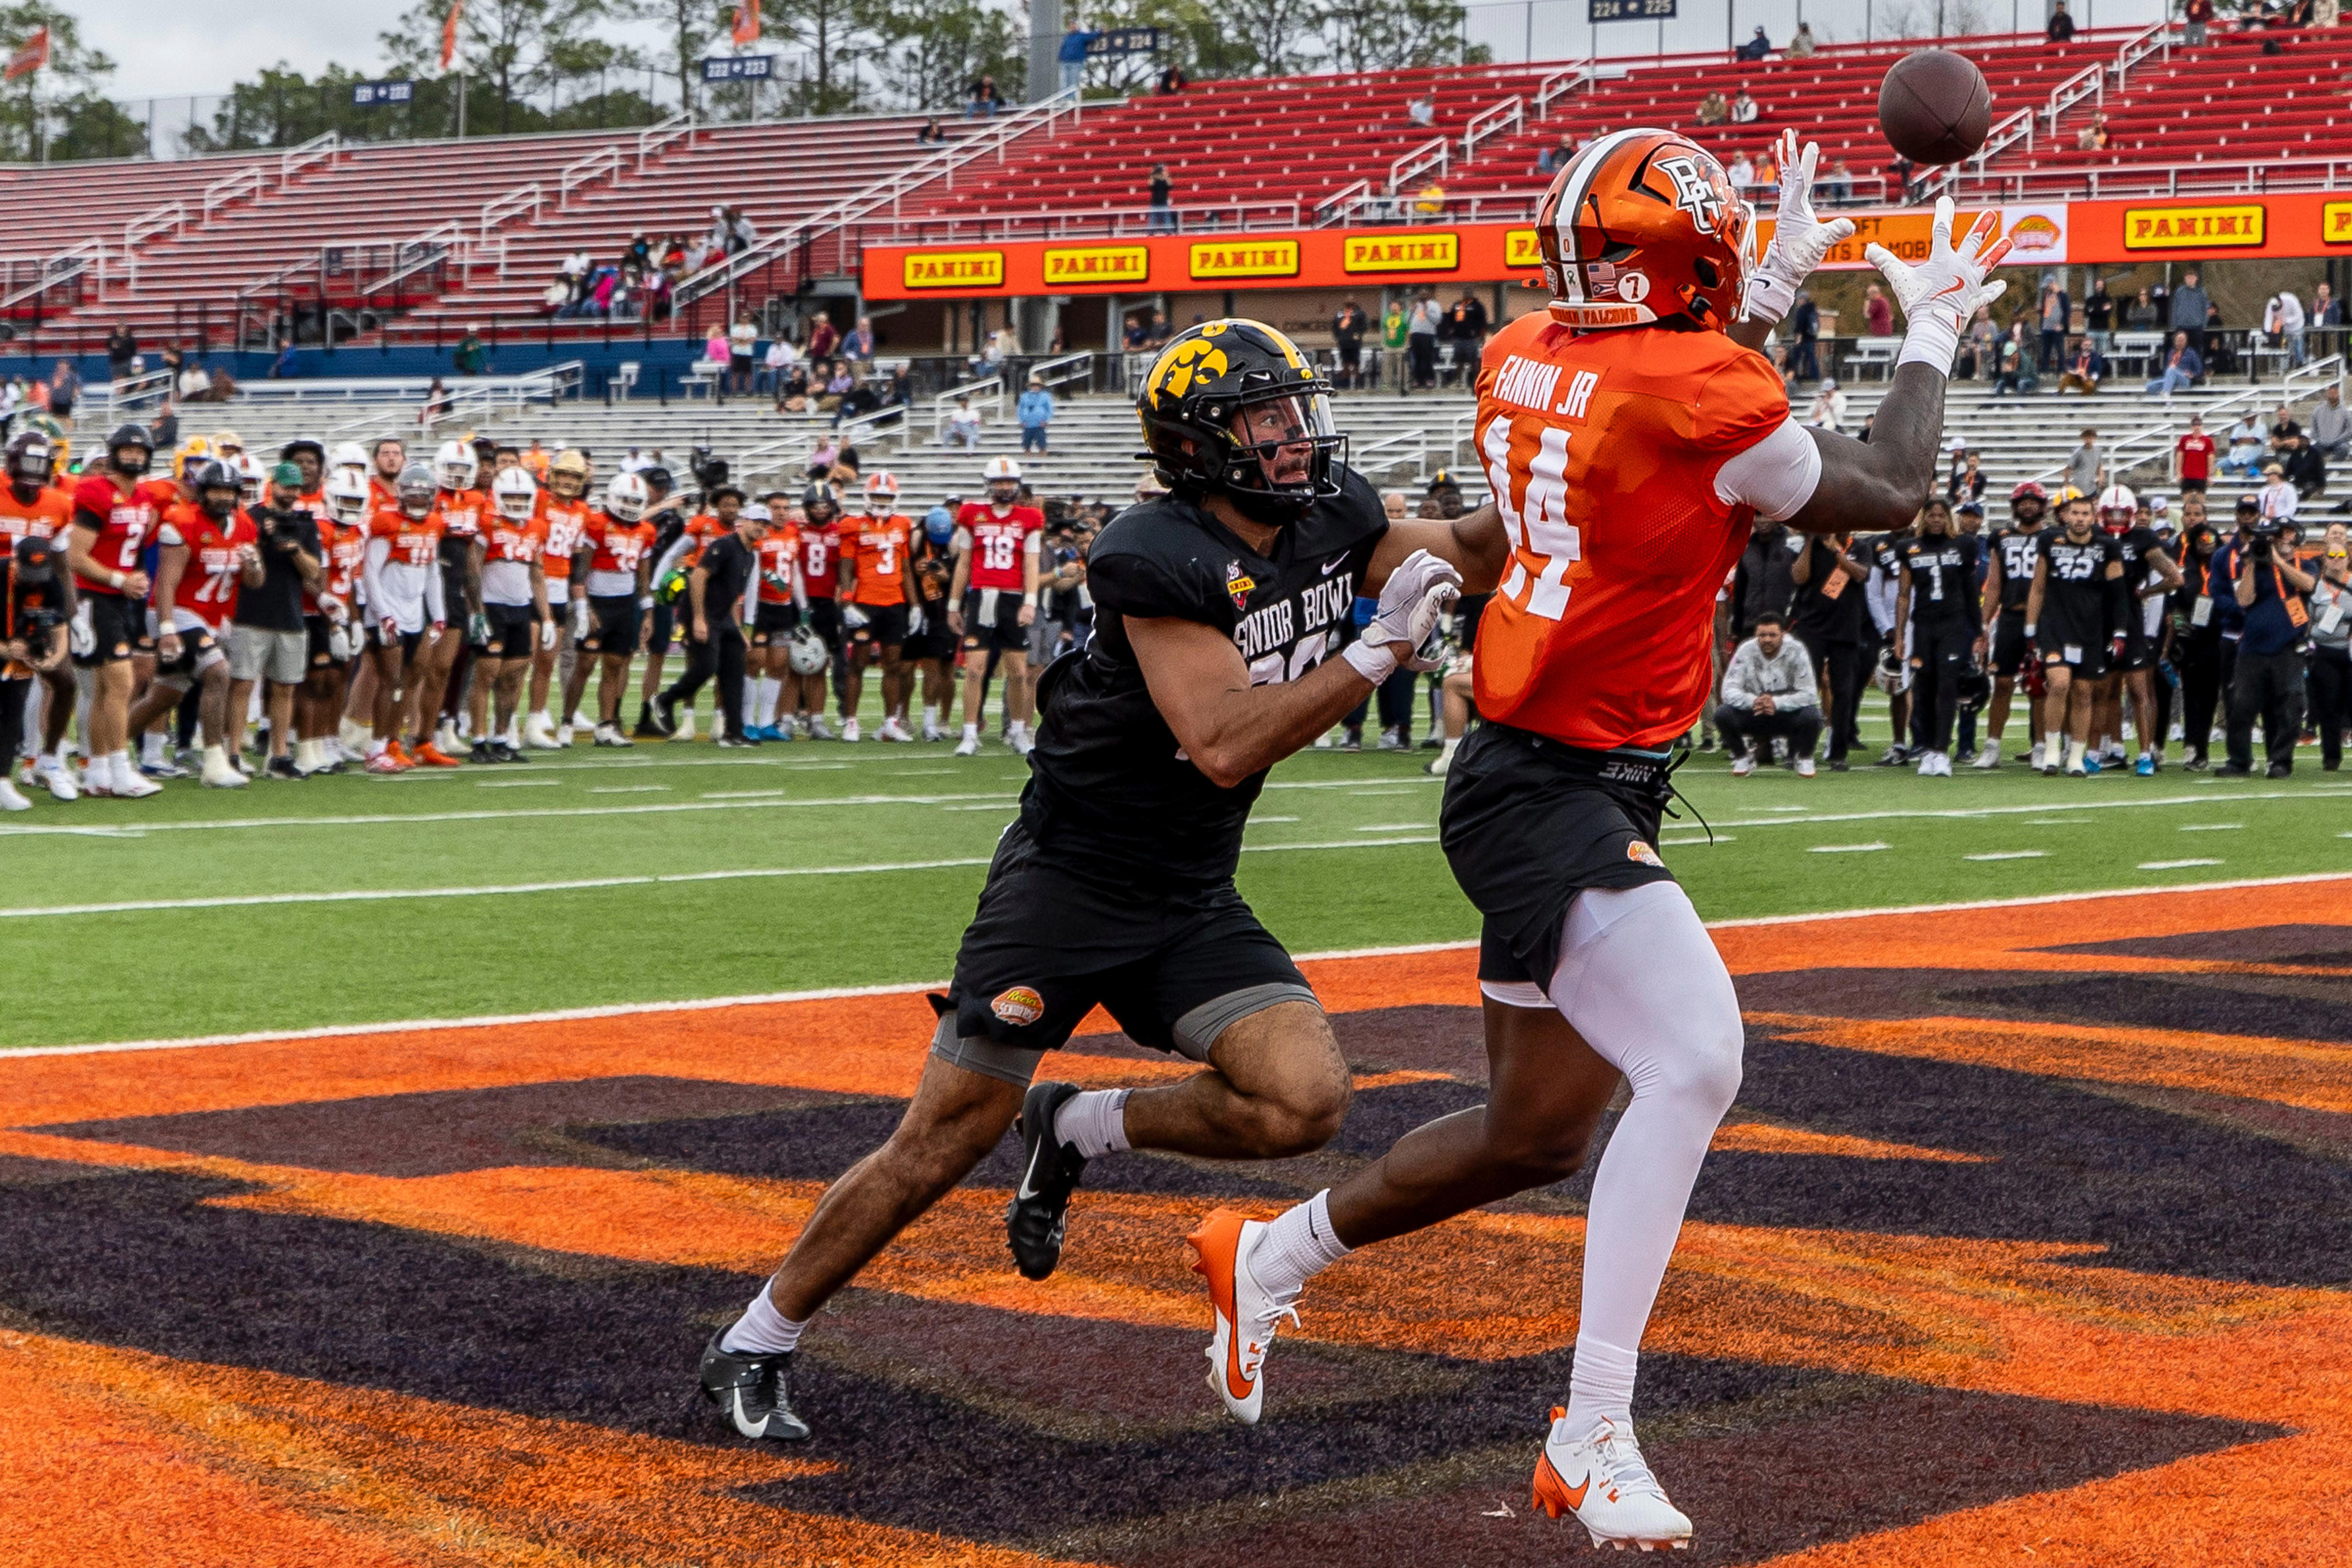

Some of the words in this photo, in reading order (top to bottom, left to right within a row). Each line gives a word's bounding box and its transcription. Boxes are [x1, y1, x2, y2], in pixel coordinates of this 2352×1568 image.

[2134, 215, 2253, 239] PANINI
[1051, 255, 1140, 274] PANINI
[1198, 249, 1291, 270] PANINI
[1353, 243, 1449, 263] PANINI
[912, 260, 996, 278] PANINI
[1626, 276, 1640, 299] 7
[1492, 354, 1562, 412] FANNIN
[1556, 370, 1599, 418] JR
[808, 543, 826, 577] 8
[983, 536, 1015, 570] 18
[1929, 565, 1944, 601] 1
[1232, 598, 1293, 660] SNIOR
